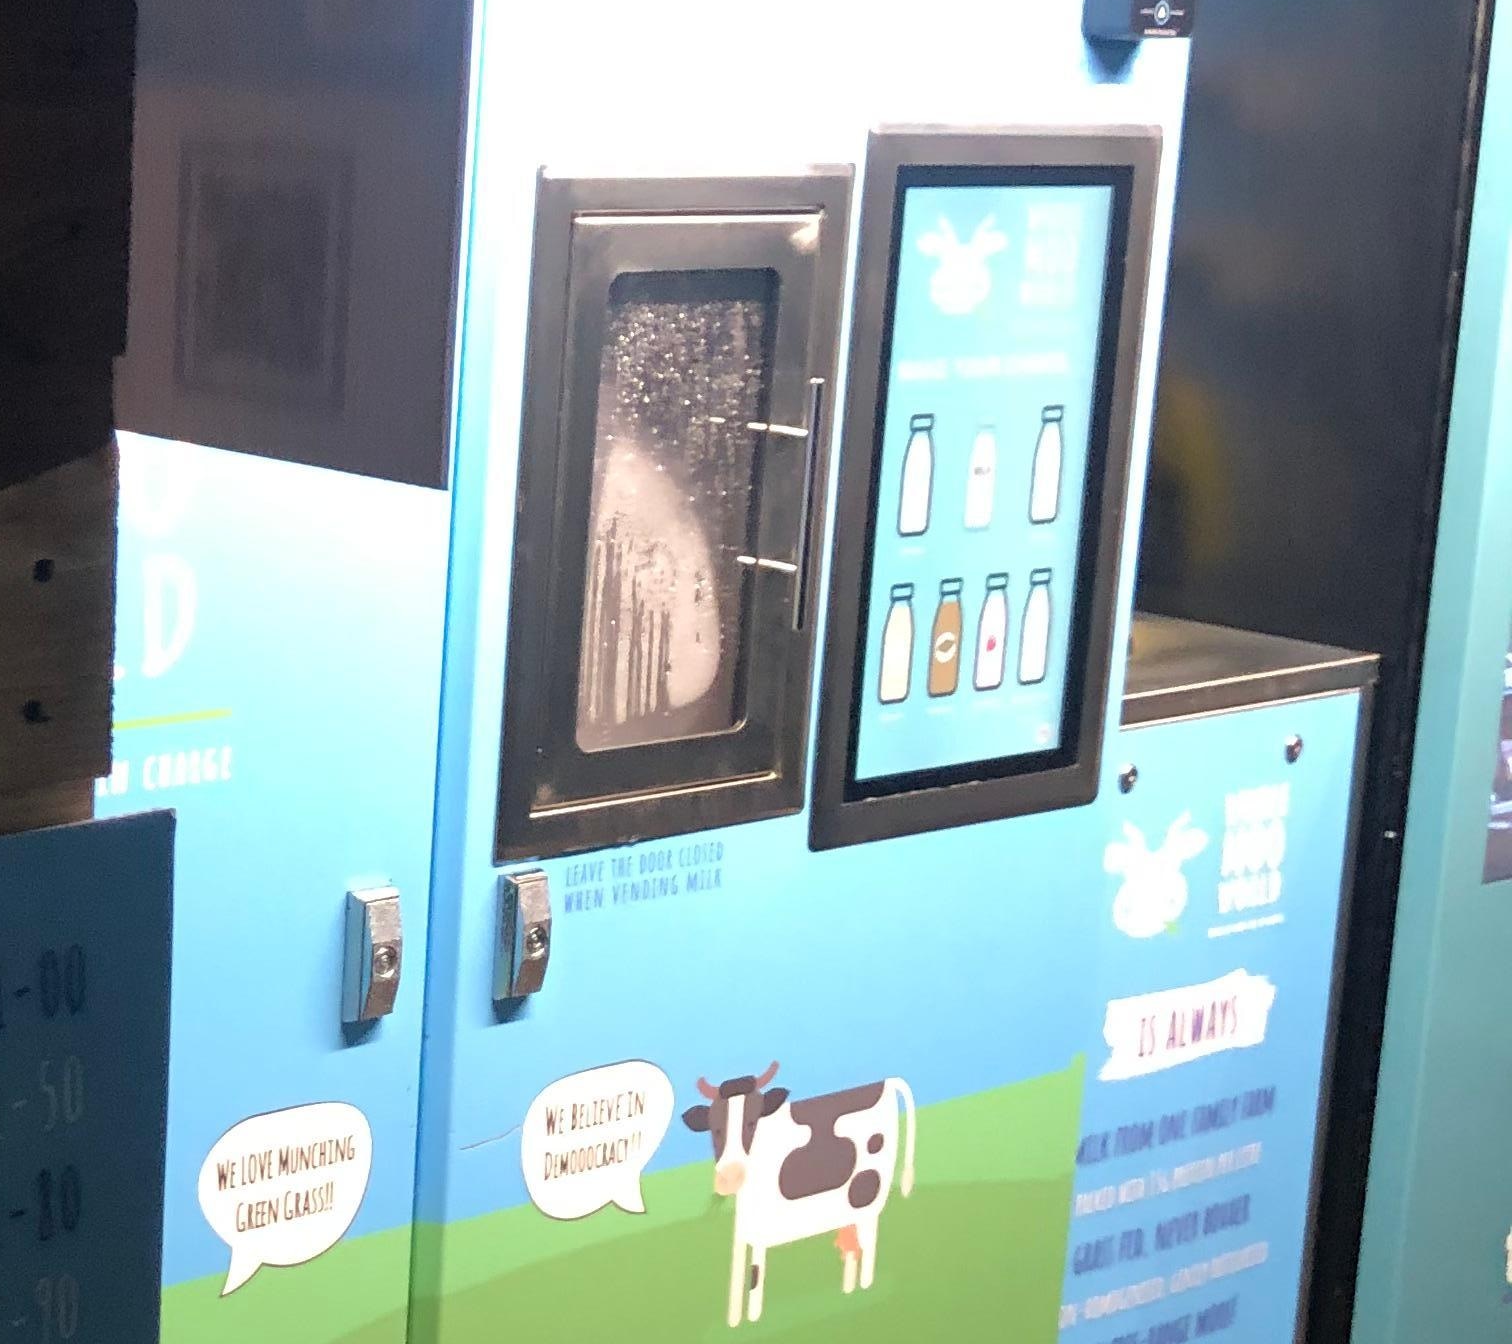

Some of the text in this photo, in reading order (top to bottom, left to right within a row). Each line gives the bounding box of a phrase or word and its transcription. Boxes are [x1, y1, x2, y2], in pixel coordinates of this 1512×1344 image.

[565, 842, 724, 888] LEAVE THE DOOR CLOSED
[564, 868, 723, 913] WHEN VENDING MILK
[1137, 995, 1238, 1058] IS ALWAYS
[545, 1090, 645, 1137] WE BELIEVE IN
[216, 1134, 356, 1192] WE LOVE MUNCHING
[236, 1181, 335, 1233] GREEN GRASS!!
